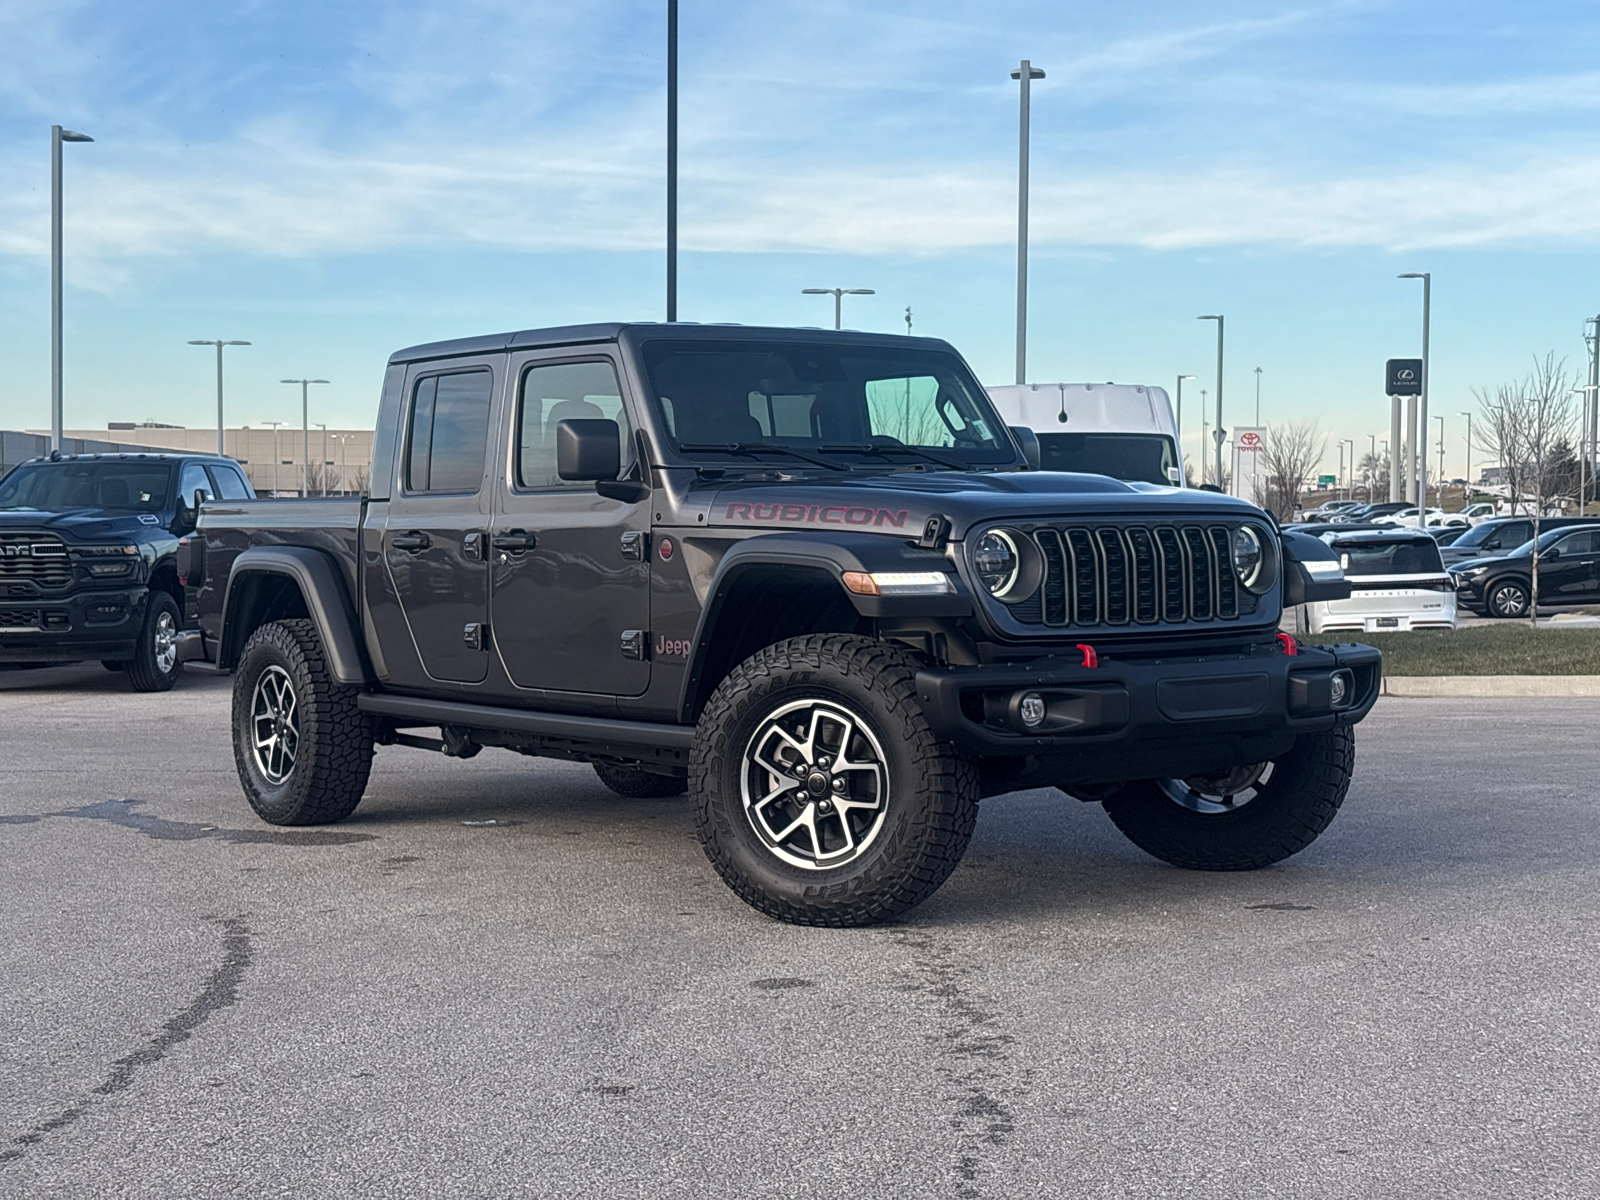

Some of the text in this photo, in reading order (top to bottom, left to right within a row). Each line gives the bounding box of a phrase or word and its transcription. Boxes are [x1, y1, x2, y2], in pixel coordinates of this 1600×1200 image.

[725, 502, 909, 528] RUBICON
[655, 634, 692, 659] Jeep
[710, 683, 764, 838] WILDPEAK
